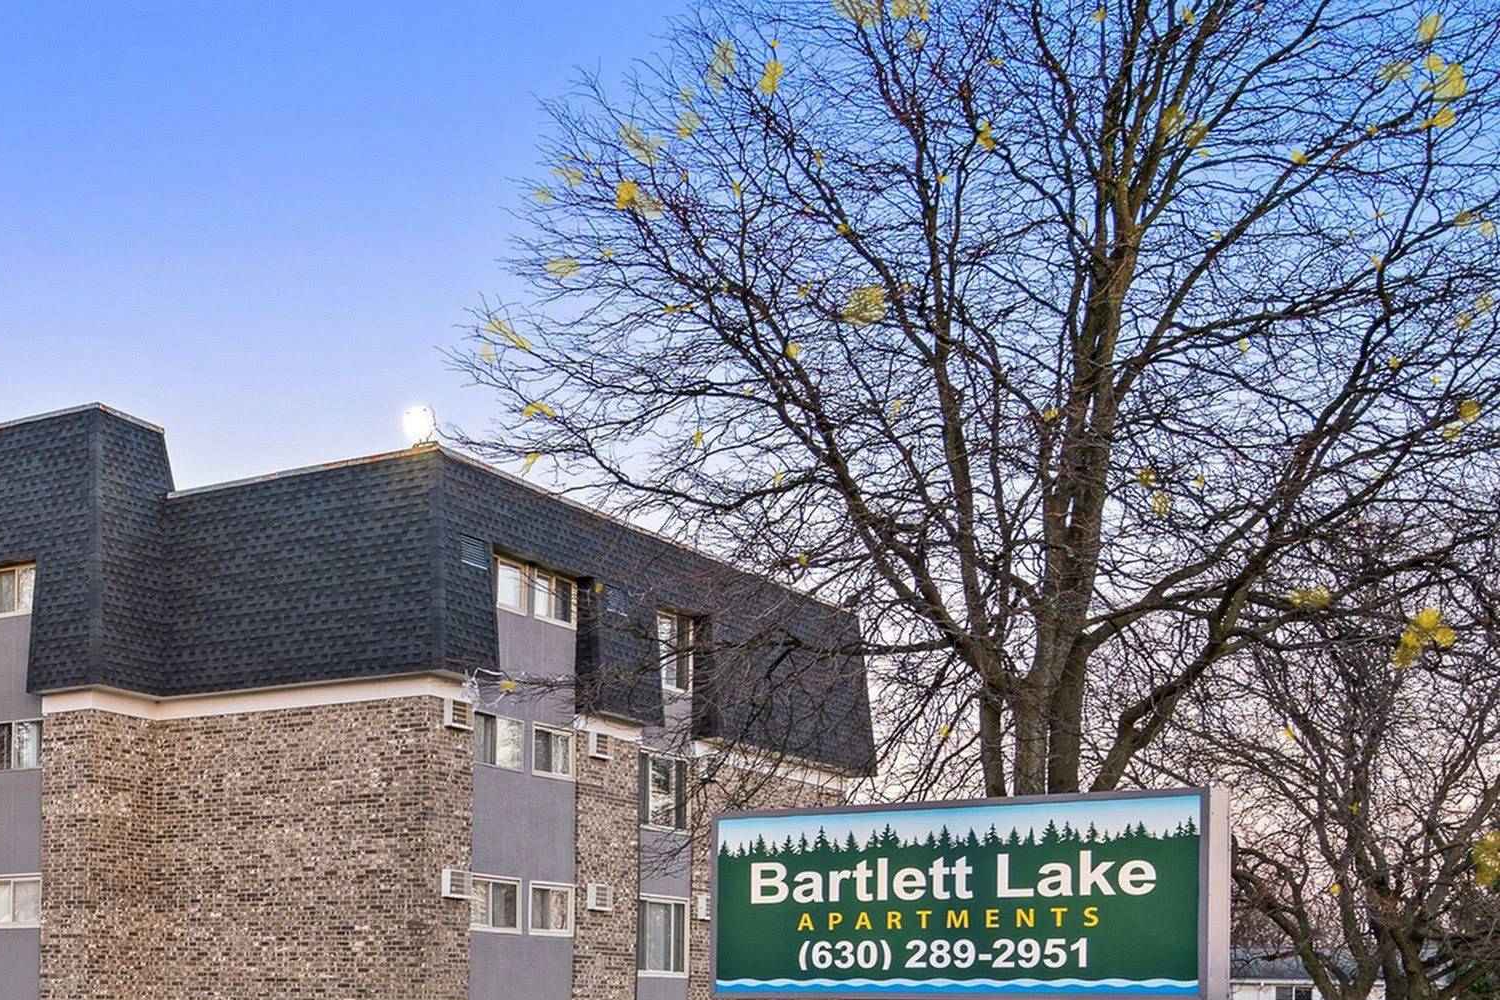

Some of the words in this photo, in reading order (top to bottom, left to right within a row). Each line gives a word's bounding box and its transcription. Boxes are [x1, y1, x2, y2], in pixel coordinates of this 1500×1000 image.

[750, 857, 974, 905] Bartlett
[996, 850, 1157, 898] Lake
[797, 906, 1100, 931] APARTMENTS
[798, 939, 892, 971] (630)
[904, 937, 1089, 969] 289-2951
